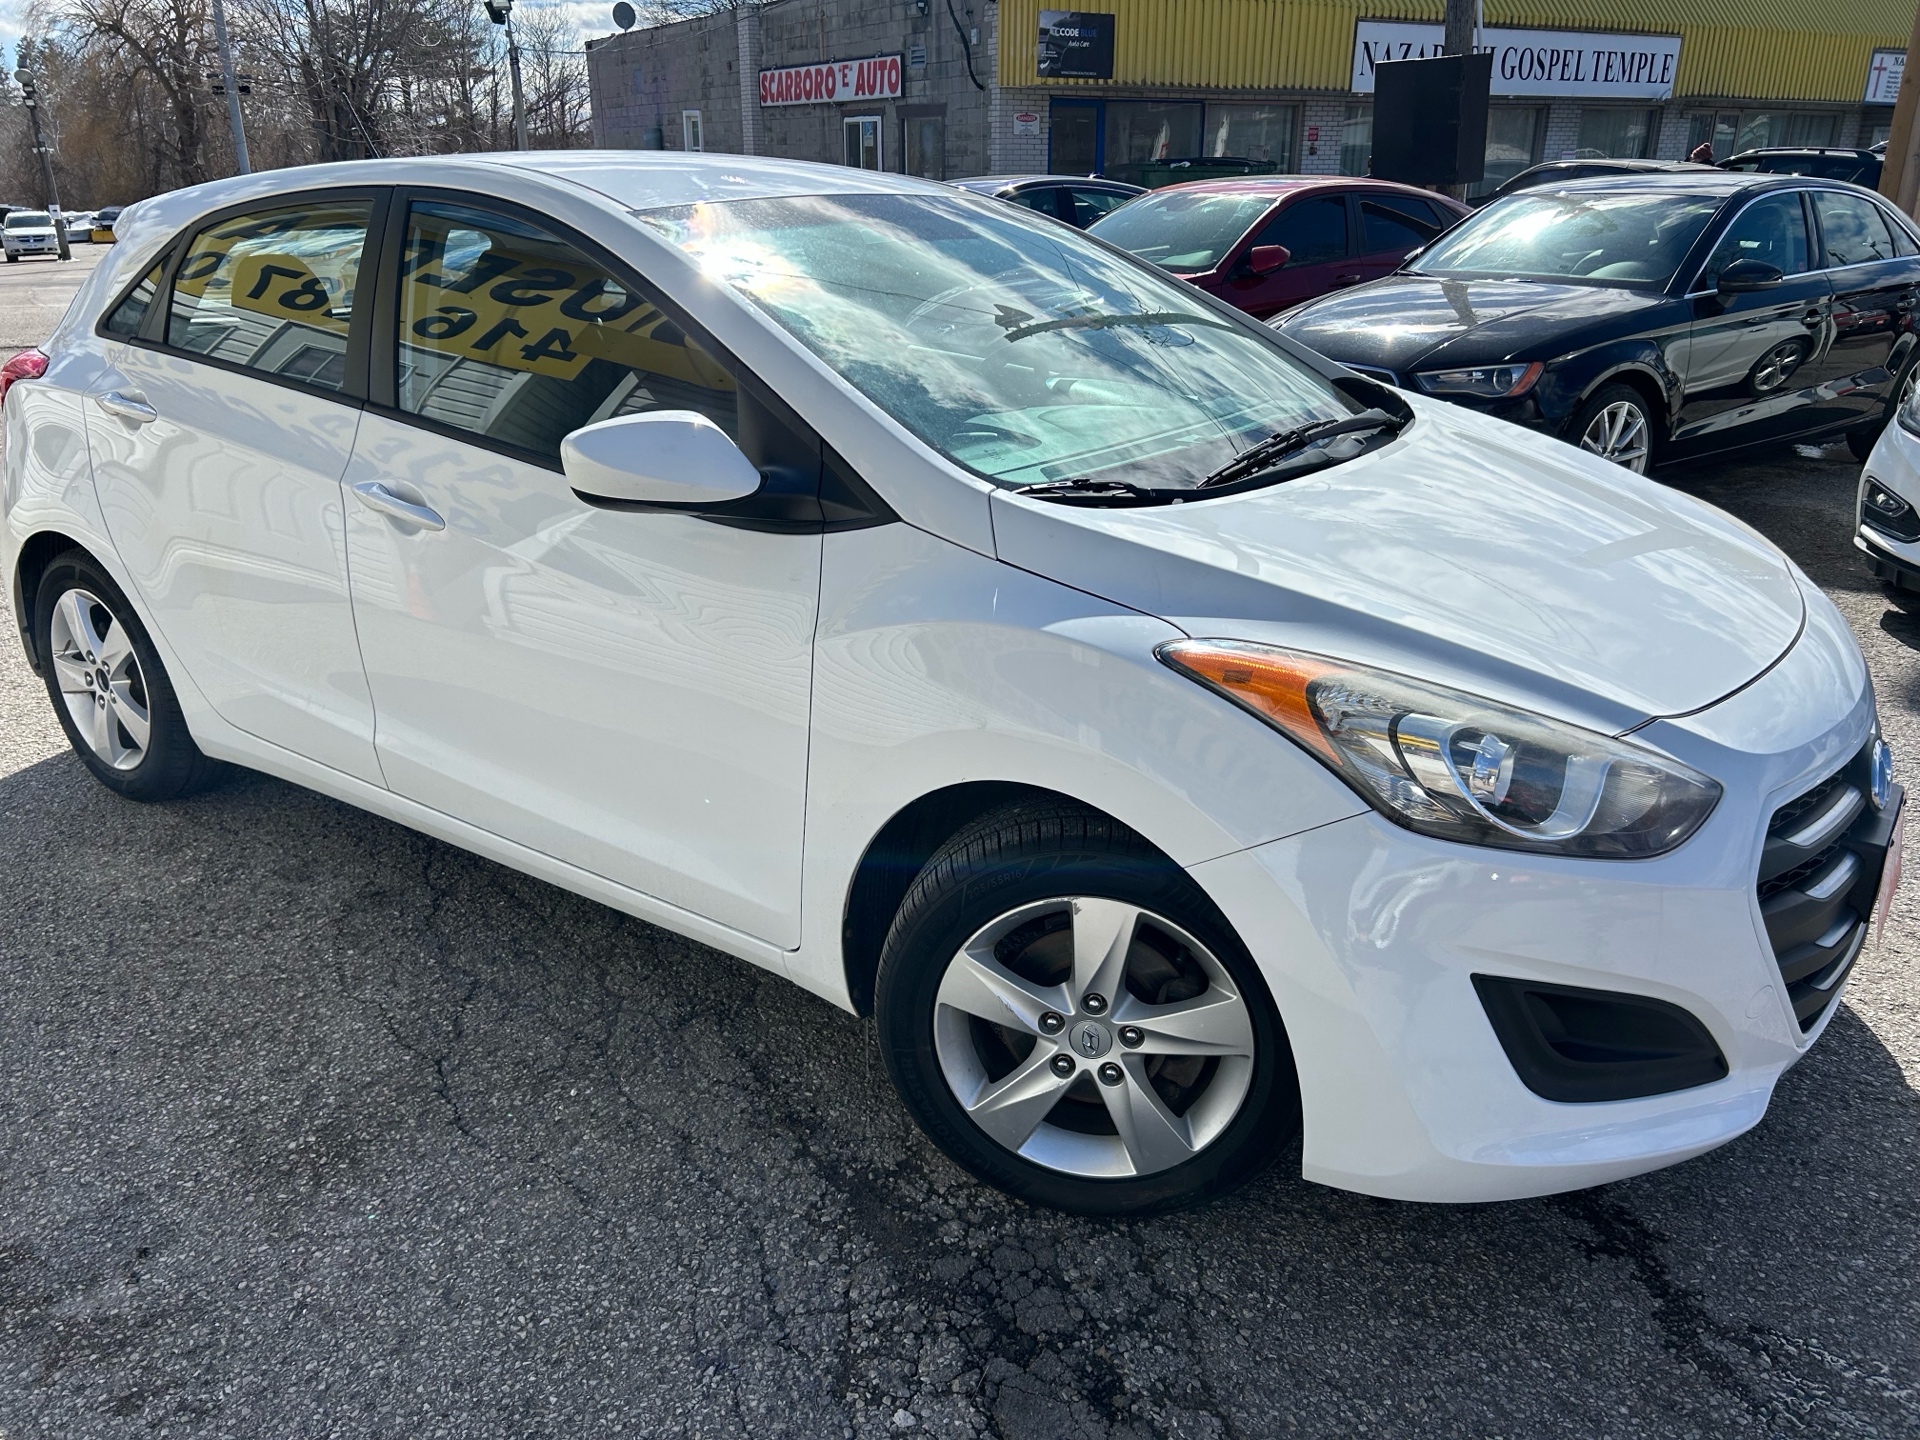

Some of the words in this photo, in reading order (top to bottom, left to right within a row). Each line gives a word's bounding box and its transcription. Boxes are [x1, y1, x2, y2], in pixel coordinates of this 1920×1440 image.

[761, 66, 836, 103] SCARBORO
[854, 58, 900, 96] AUTO
[1500, 46, 1586, 82] GOSPEL
[1591, 50, 1673, 84] TEMPLE
[966, 869, 1023, 901] 205/55R16
